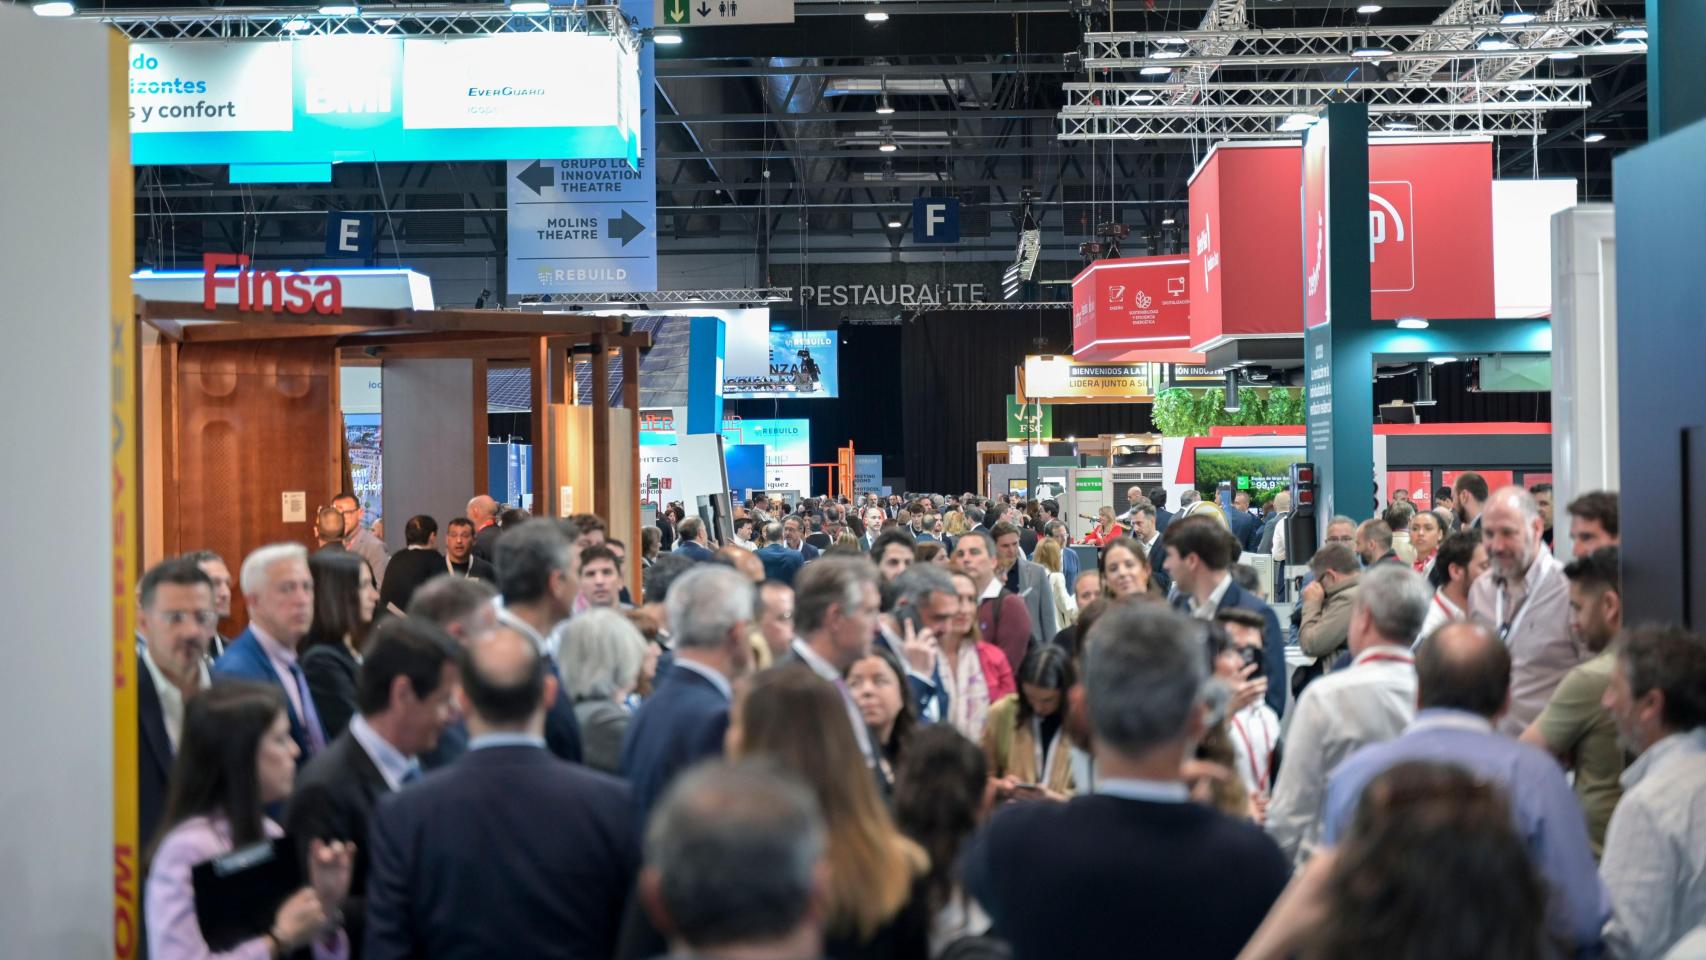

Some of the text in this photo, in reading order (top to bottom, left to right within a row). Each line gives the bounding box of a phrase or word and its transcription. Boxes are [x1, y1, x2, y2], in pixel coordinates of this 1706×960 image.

[141, 106, 153, 123] y
[158, 100, 236, 119] confort
[561, 157, 645, 169] GRUPO LOE
[561, 170, 642, 181] INNOVATION
[561, 182, 622, 193] THEATRE
[547, 217, 598, 228] MOLINS
[925, 203, 946, 237] F
[338, 218, 360, 252] E
[537, 229, 598, 240] THEATRE
[555, 268, 627, 281] REBUILD
[203, 252, 343, 315] Finsa
[1072, 367, 1122, 375] BIENVENIDOS
[1123, 367, 1129, 375] A
[1130, 367, 1141, 375] LA
[1069, 379, 1100, 388] LIDERA
[1101, 379, 1128, 389] JUNTO
[1129, 379, 1136, 388] A
